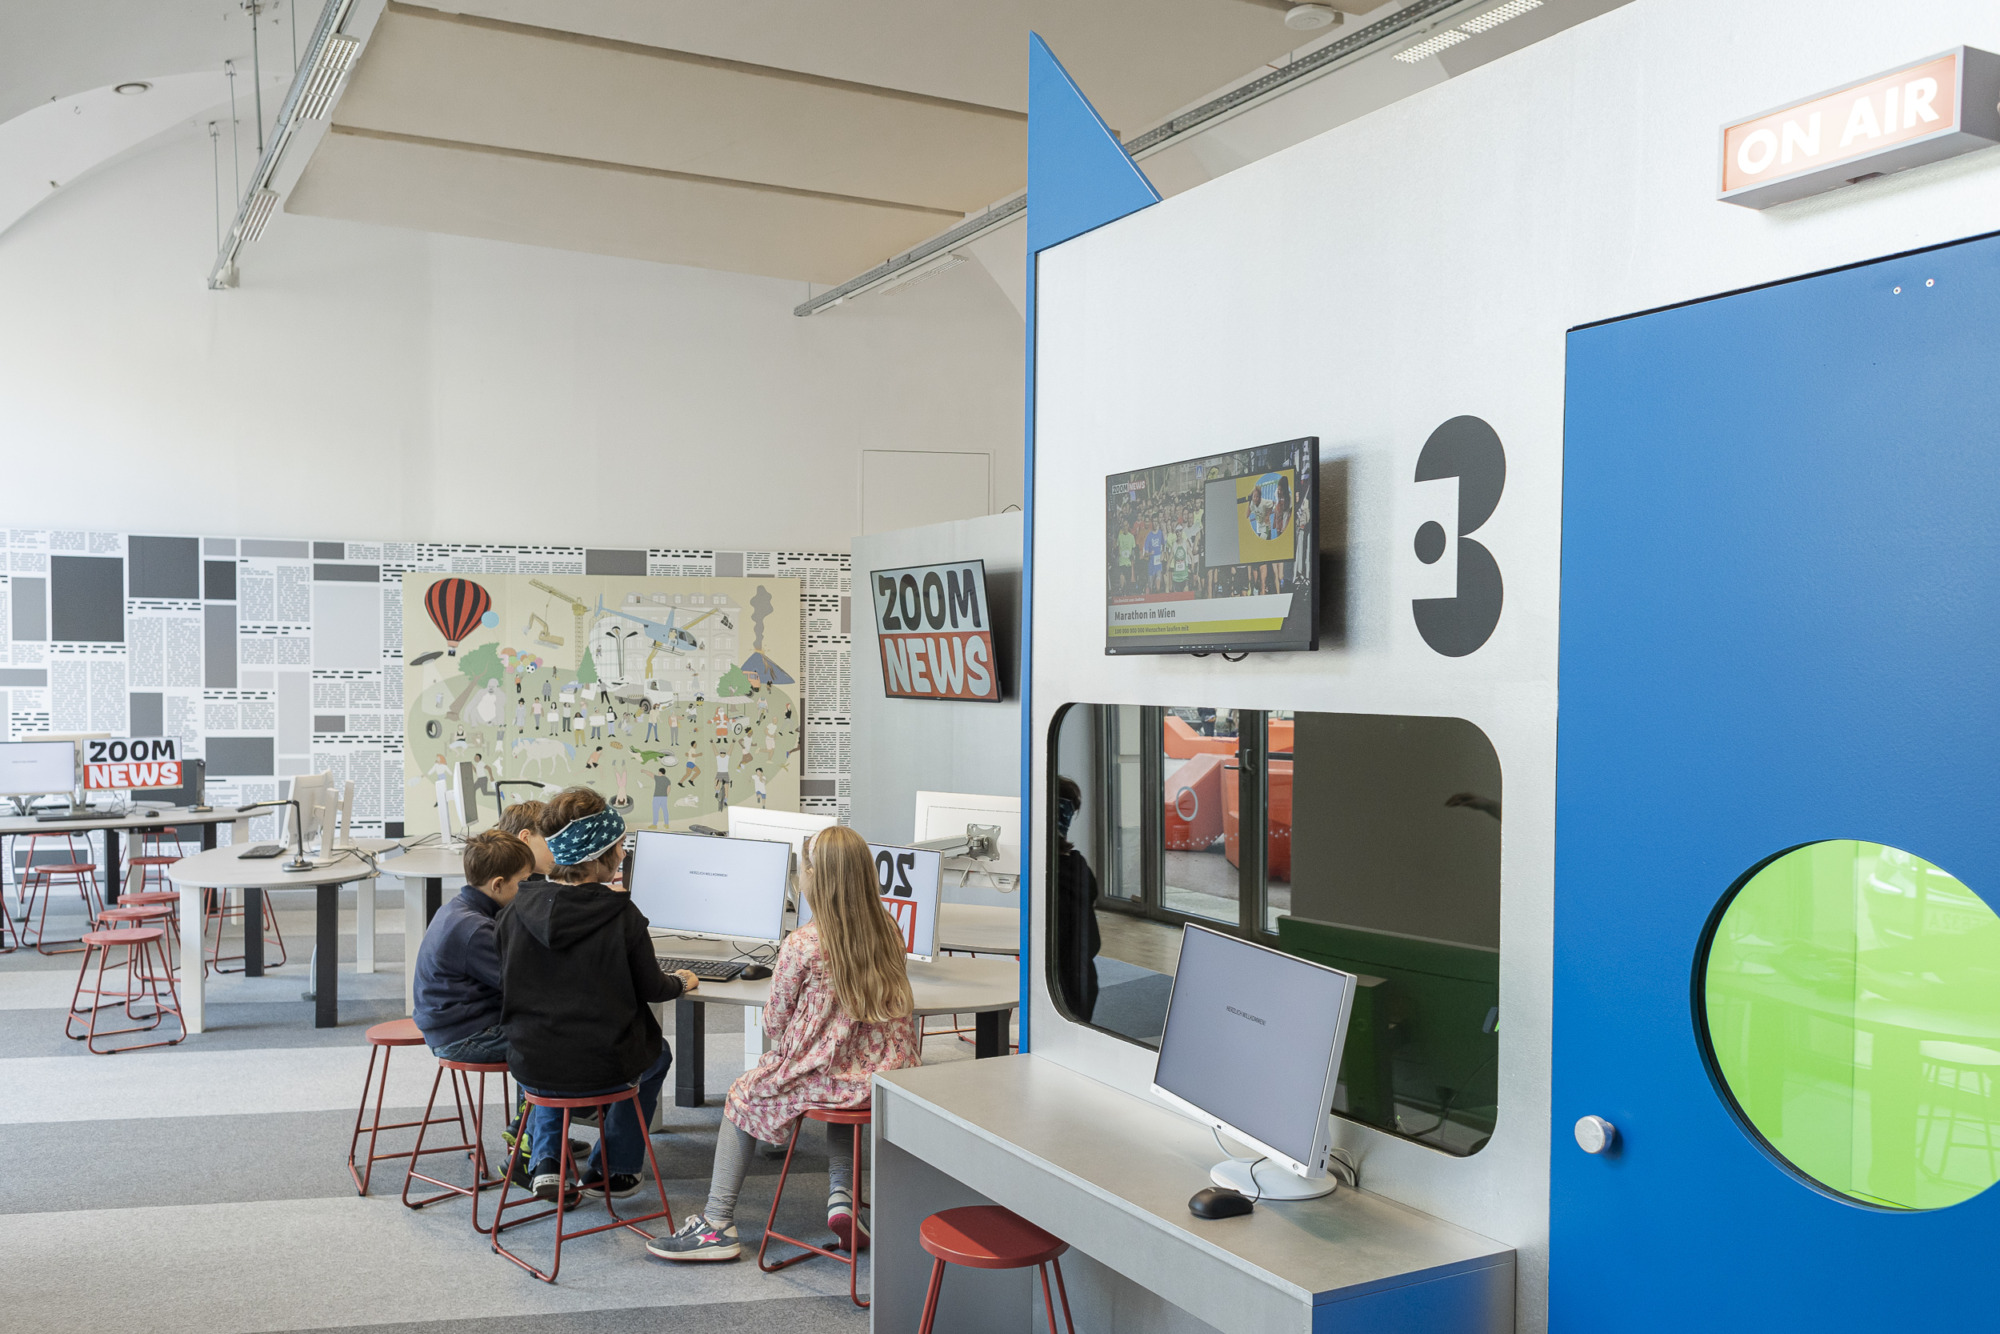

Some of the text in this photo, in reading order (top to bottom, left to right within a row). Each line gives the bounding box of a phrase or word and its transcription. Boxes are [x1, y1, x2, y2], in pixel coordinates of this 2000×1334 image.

[1737, 77, 1940, 175] ON AIR
[1411, 414, 1506, 657] 3
[878, 569, 982, 631] ZOOM
[1114, 608, 1176, 621] Marathon in Wien
[884, 635, 991, 696] NEWS
[88, 762, 179, 789] NEWS
[89, 740, 175, 763] ZOOM
